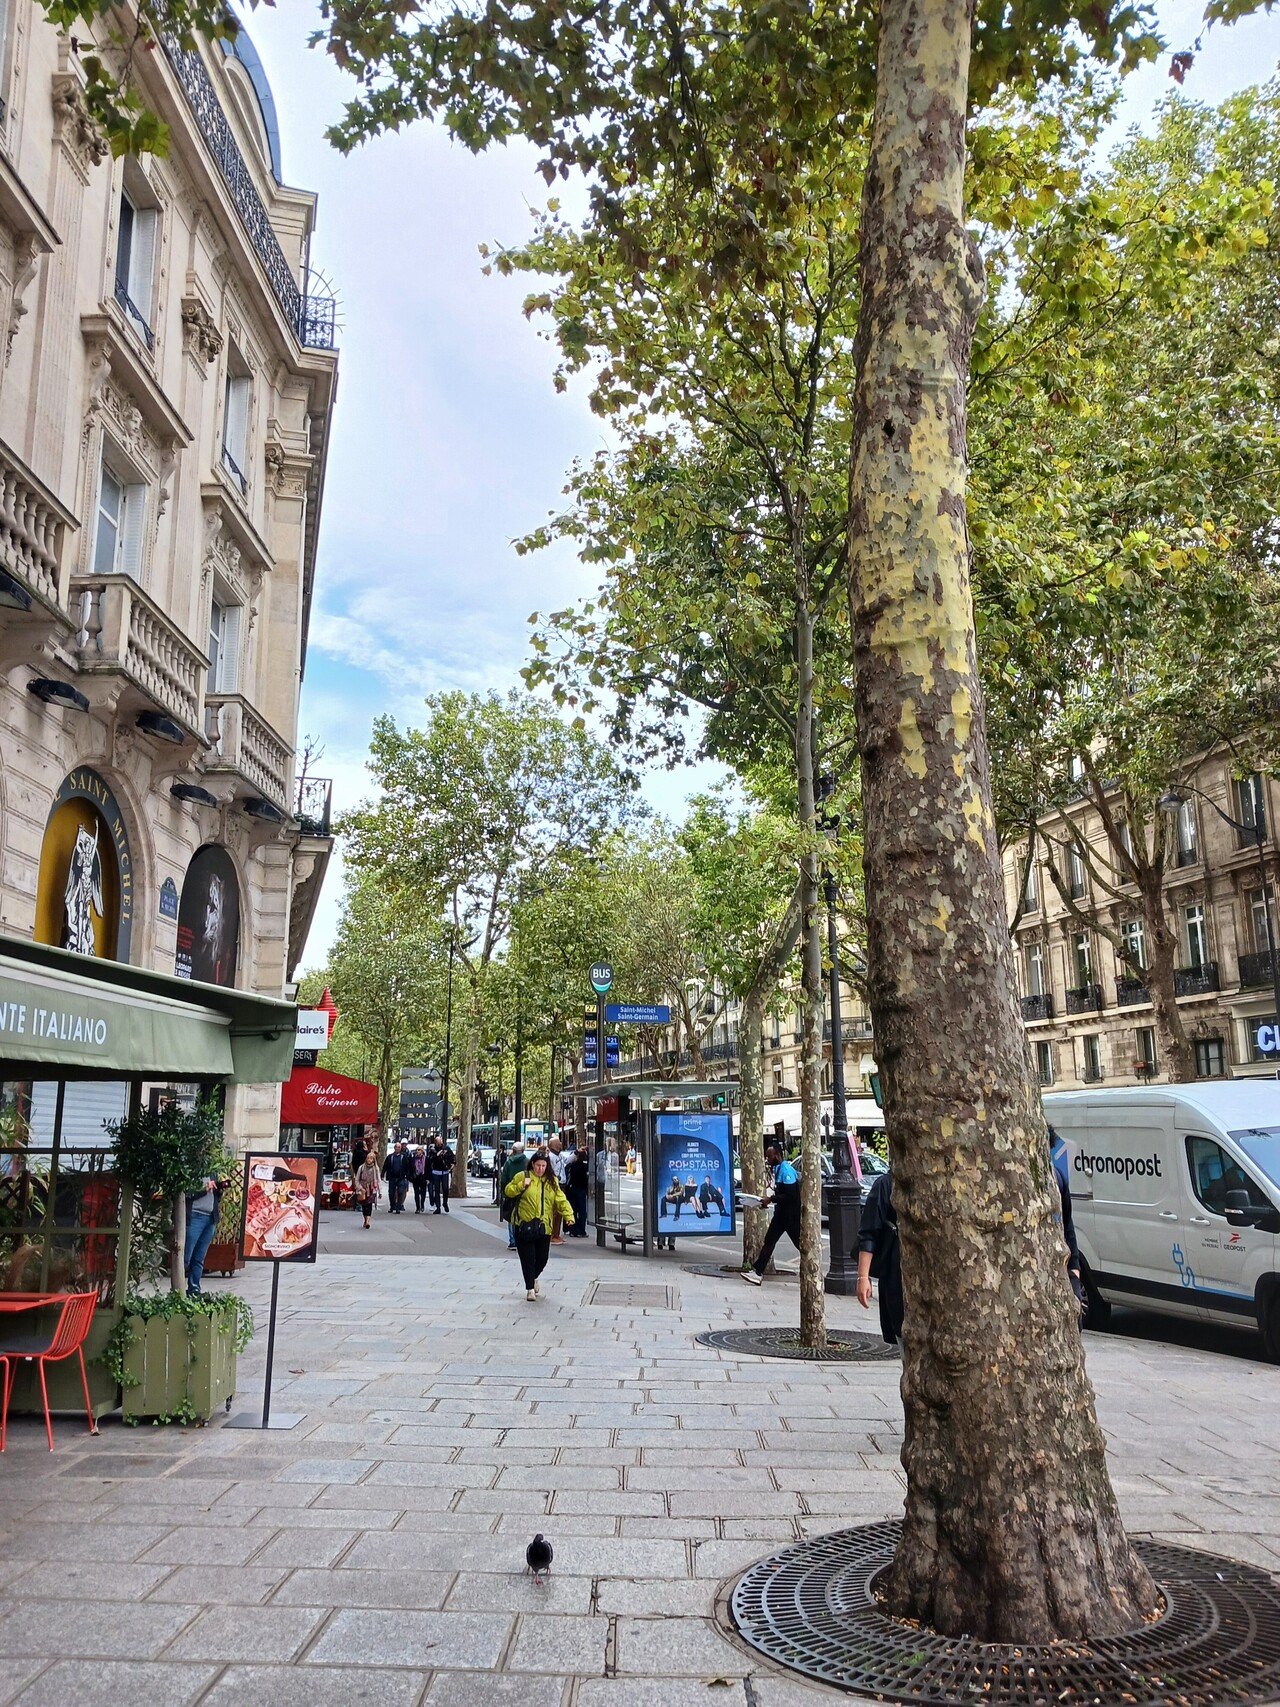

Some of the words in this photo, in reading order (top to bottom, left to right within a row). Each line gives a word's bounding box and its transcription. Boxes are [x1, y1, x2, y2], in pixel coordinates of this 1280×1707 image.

[69, 772, 110, 806] SAINT
[112, 817, 132, 925] MICHEL
[592, 968, 611, 978] BUS
[32, 1007, 107, 1045] ITALIANO
[296, 1025, 325, 1035] laire's
[304, 1082, 342, 1094] Bistro
[316, 1096, 359, 1107] Crêperie
[683, 1118, 703, 1127] prime
[668, 1160, 720, 1168] POPSTARS
[1074, 1149, 1162, 1181] chronopost
[1223, 1244, 1246, 1252] GEOPOST
